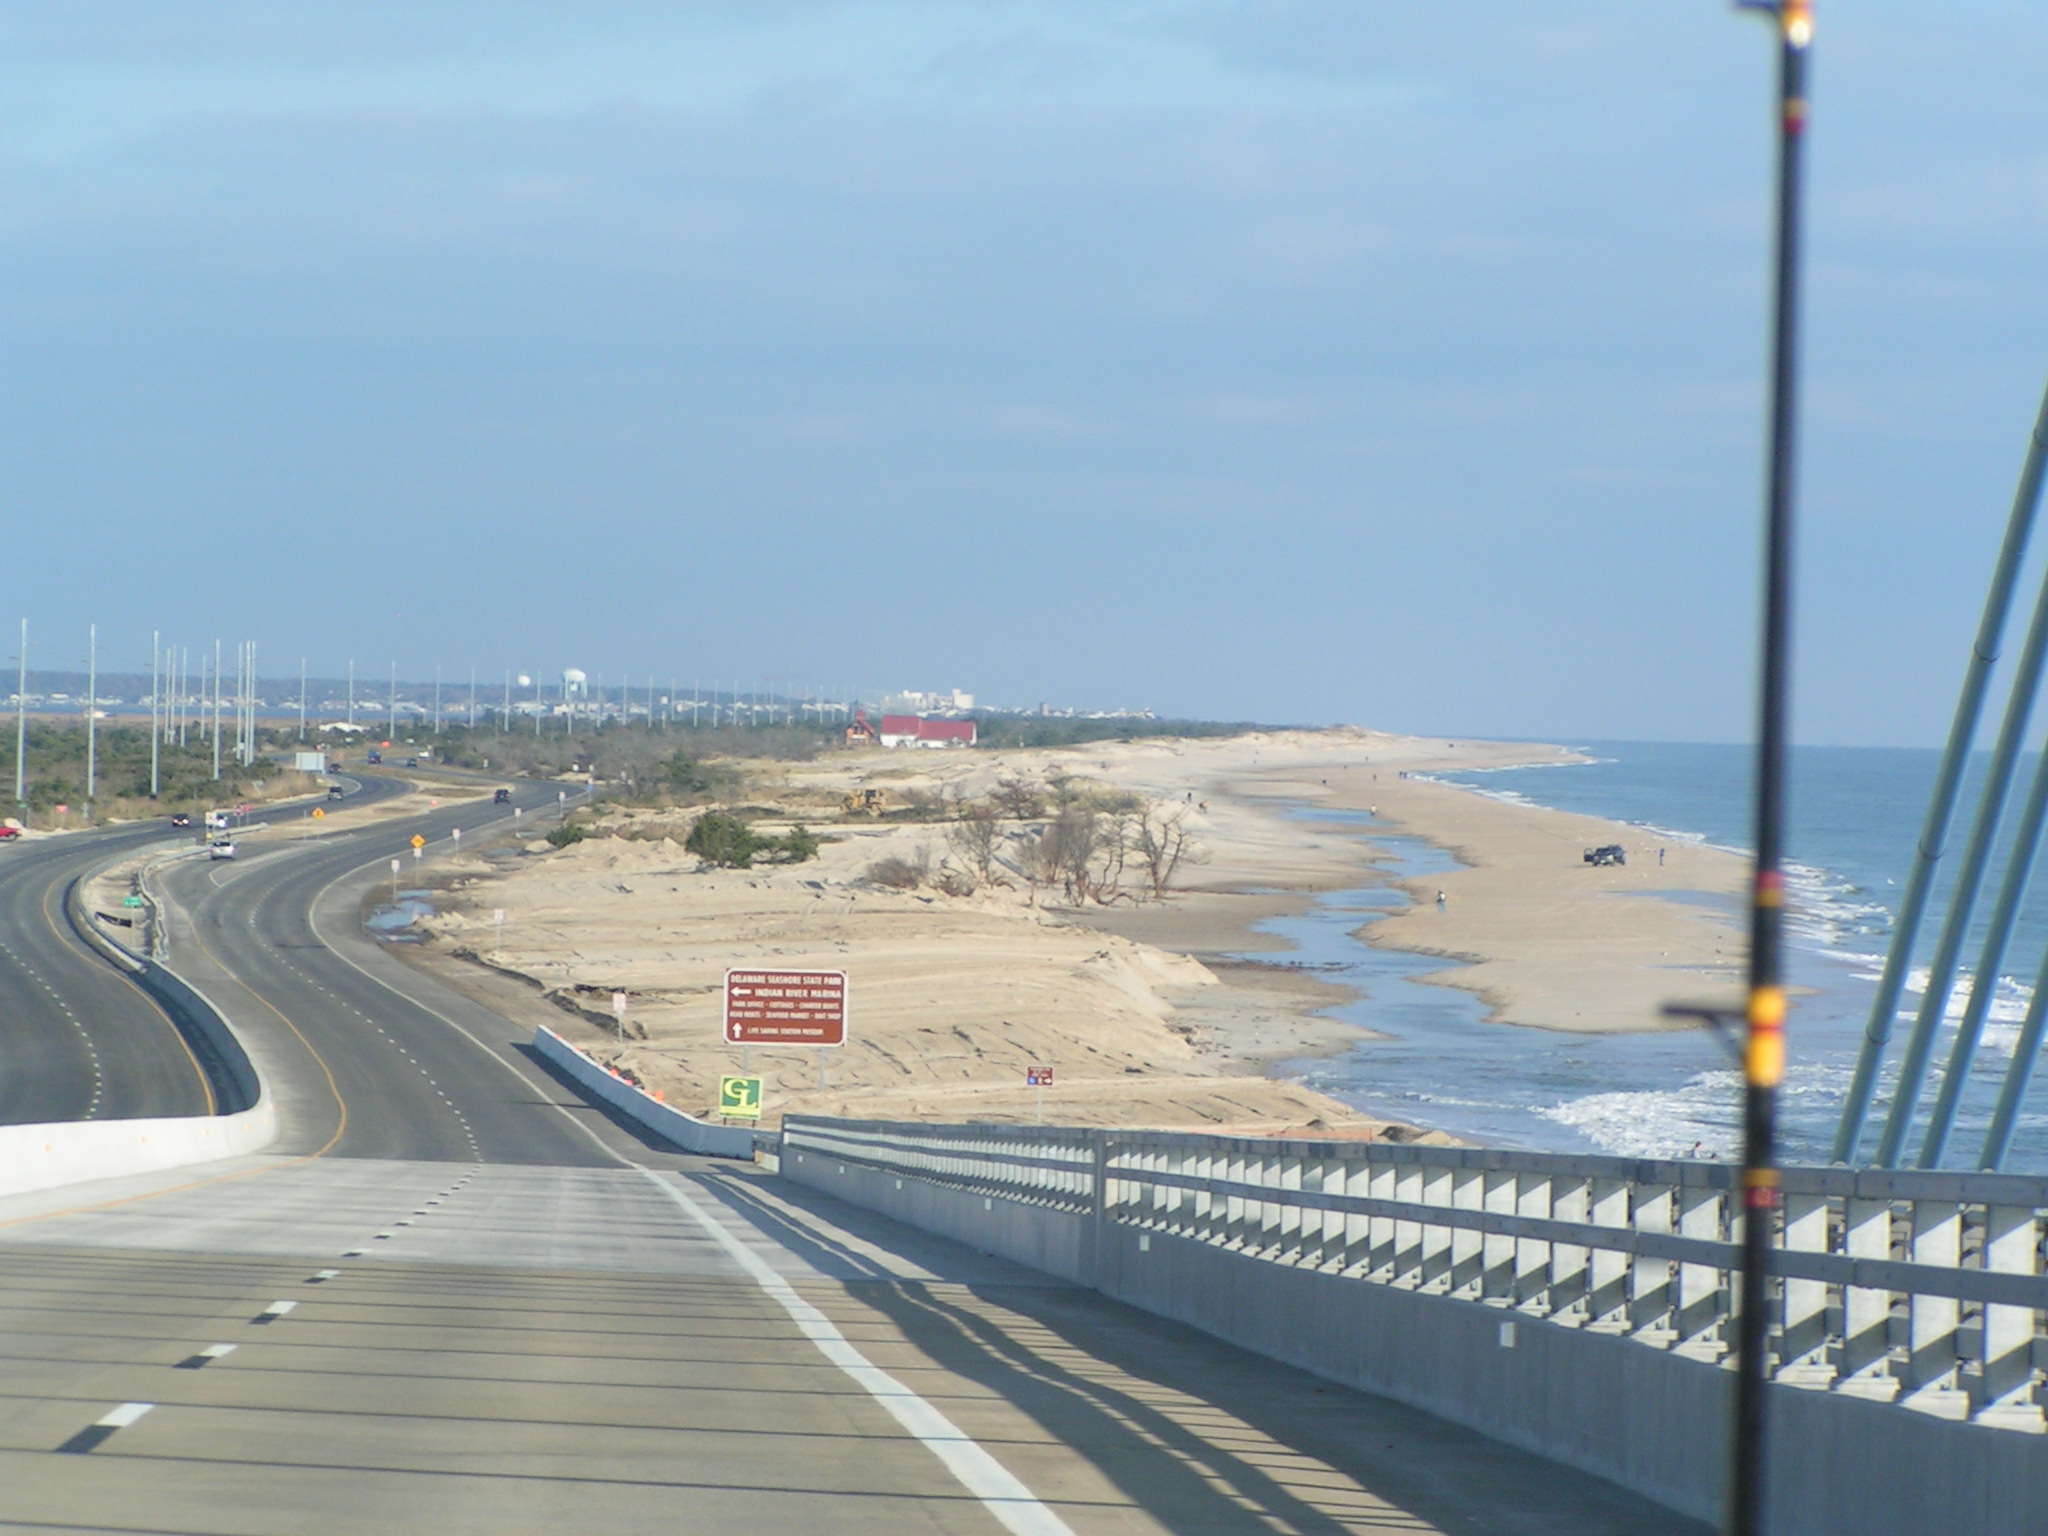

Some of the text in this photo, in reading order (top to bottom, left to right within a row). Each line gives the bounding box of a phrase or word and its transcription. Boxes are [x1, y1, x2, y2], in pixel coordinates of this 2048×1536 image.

[803, 976, 822, 985] STATE
[824, 977, 841, 985] PARK
[724, 1078, 757, 1107] G
